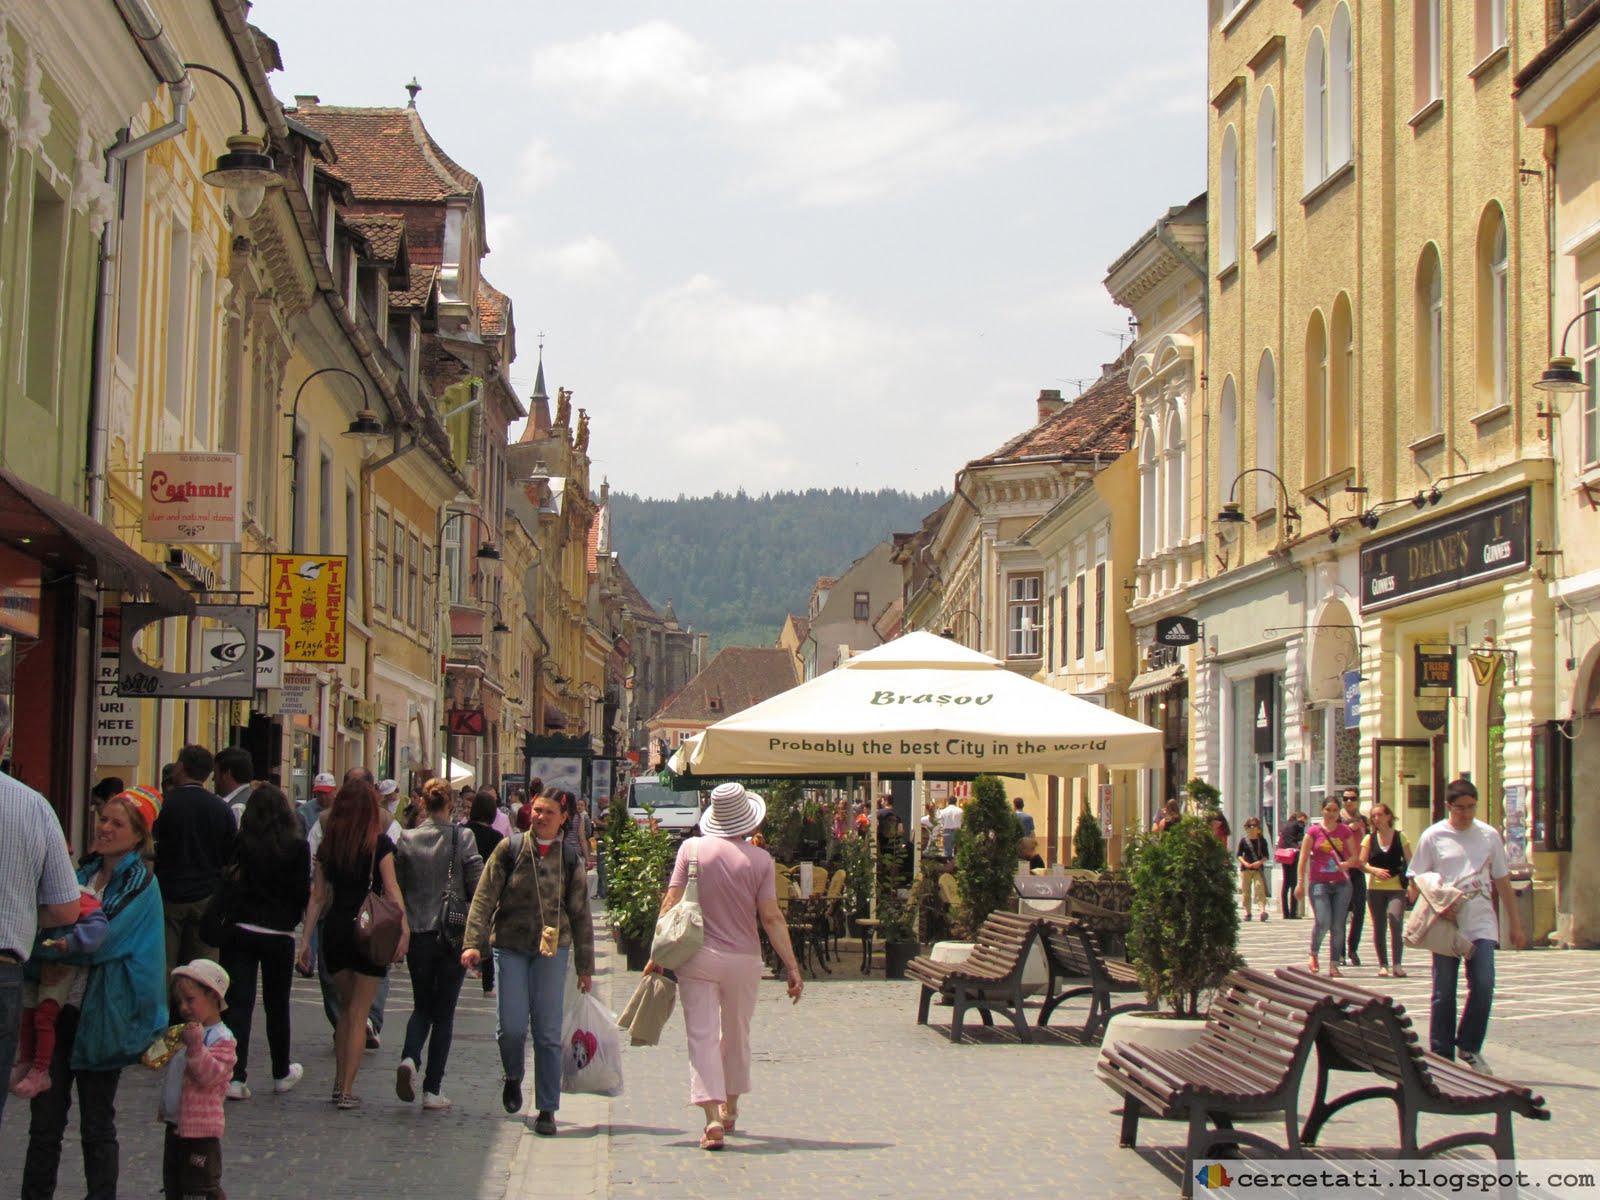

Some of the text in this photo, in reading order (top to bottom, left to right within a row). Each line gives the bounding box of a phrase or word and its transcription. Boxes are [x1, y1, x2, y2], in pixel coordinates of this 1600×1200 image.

[151, 470, 233, 504] Cashmir
[295, 640, 323, 650] Flash
[1431, 671, 1448, 680] PUB
[870, 690, 994, 707] Brașov
[769, 738, 1107, 758] Probably the best City in the world
